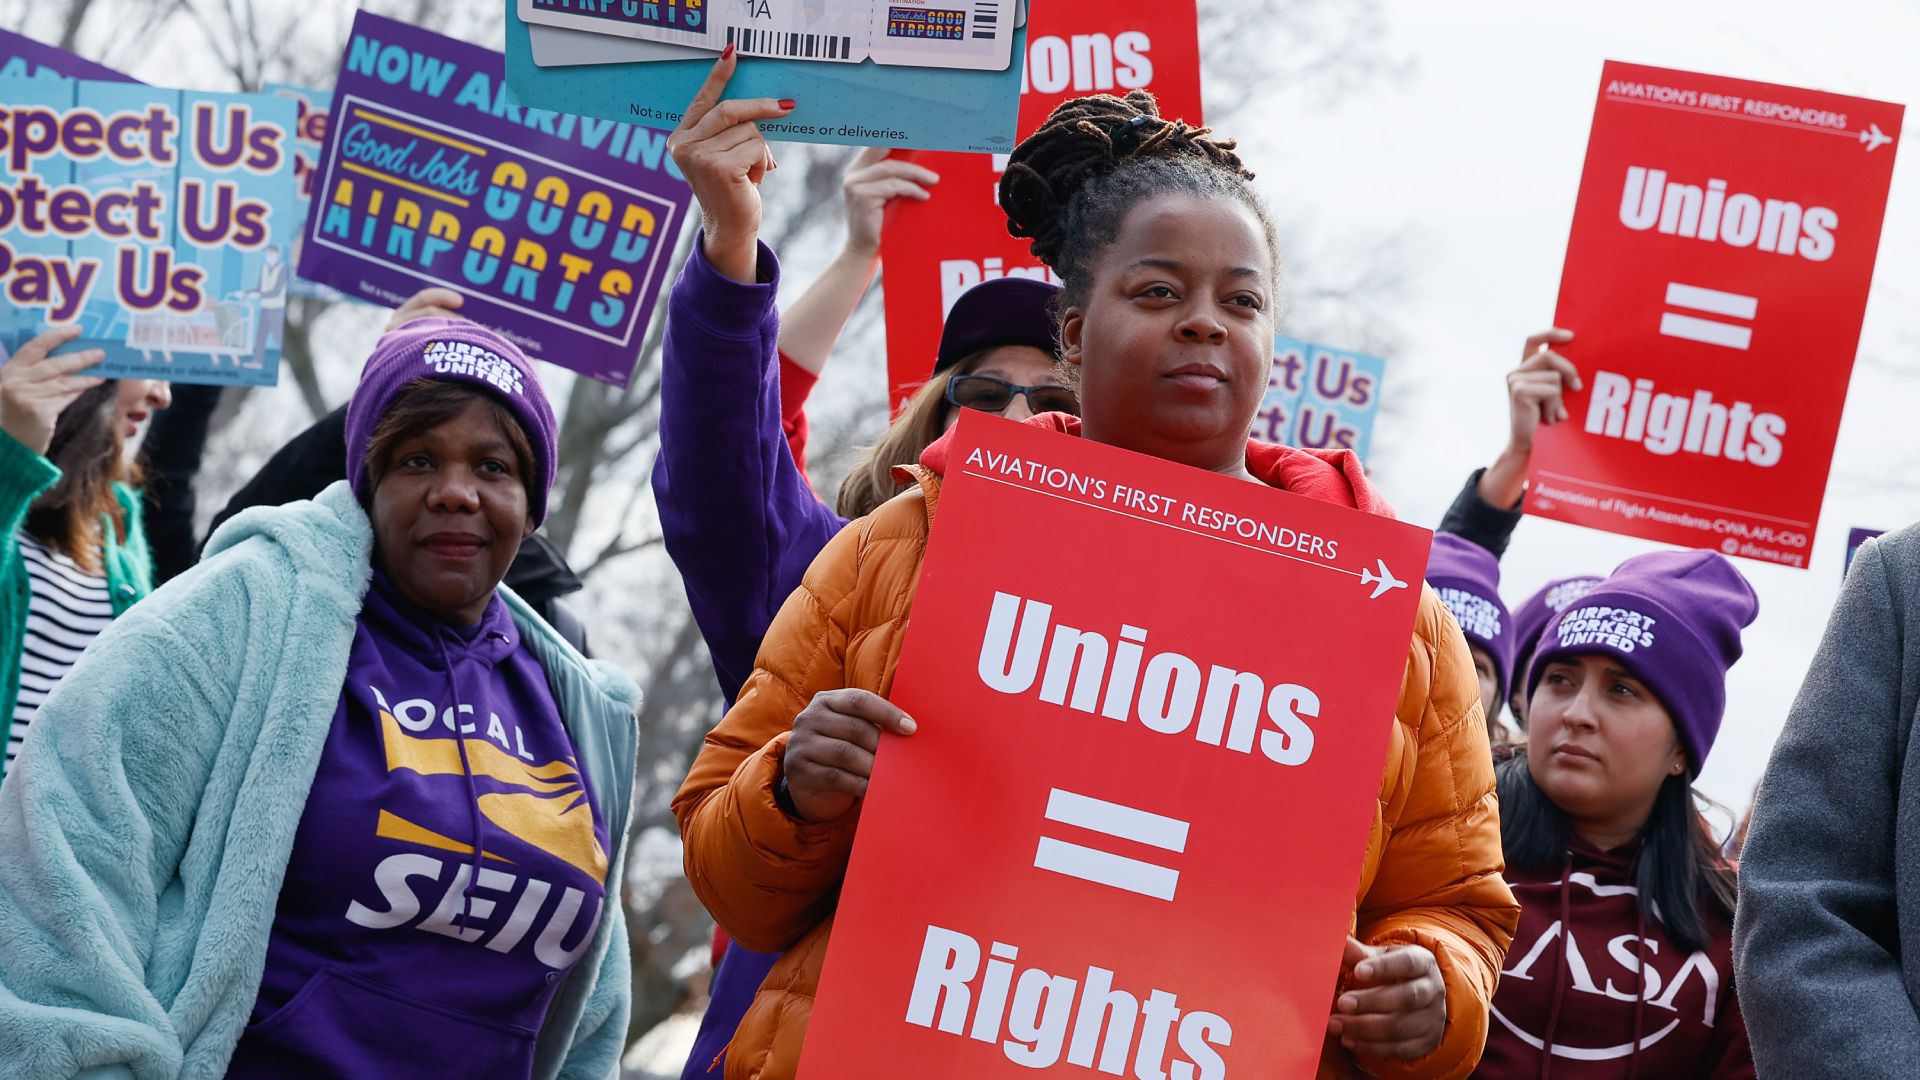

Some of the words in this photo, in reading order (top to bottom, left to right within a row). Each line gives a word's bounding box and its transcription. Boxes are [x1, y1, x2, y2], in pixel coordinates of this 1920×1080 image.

[889, 22, 963, 38] AIRPORTS
[890, 11, 909, 20] Good
[909, 12, 927, 21] Jobs
[927, 11, 964, 25] GOOD
[347, 34, 457, 98] NOW
[630, 103, 651, 119] Not
[656, 109, 665, 119] a
[759, 121, 815, 135] services
[819, 125, 834, 136] or
[837, 123, 909, 140] deliveries.
[1607, 79, 1697, 107] AVIATION'S
[1699, 91, 1741, 112] FIRST
[1744, 98, 1848, 130] RESPONDERS
[0, 107, 173, 172] pect
[195, 105, 281, 171] Us
[342, 122, 418, 174] Good
[409, 148, 480, 196] Jobs
[182, 182, 268, 247] Us
[483, 161, 656, 264] GOOD
[1619, 165, 1840, 262] Unions
[118, 248, 204, 313] Us
[323, 179, 634, 328] AIRPORTS
[423, 352, 524, 395] WORKERS
[430, 341, 523, 381] AIRPORT
[435, 361, 512, 394] UNITED
[1315, 357, 1372, 406] Us
[1584, 369, 1788, 468] Rights
[966, 447, 1106, 500] AVIATION'S
[1112, 484, 1177, 517] FIRST
[1181, 502, 1339, 560] RESPONDERS
[1557, 619, 1656, 648] WORKERS
[1560, 631, 1635, 653] UNITED
[1565, 606, 1656, 631] AIRPORT
[977, 590, 1322, 767] Unions
[345, 853, 604, 971] SEIU
[905, 924, 1234, 1080] Rights
